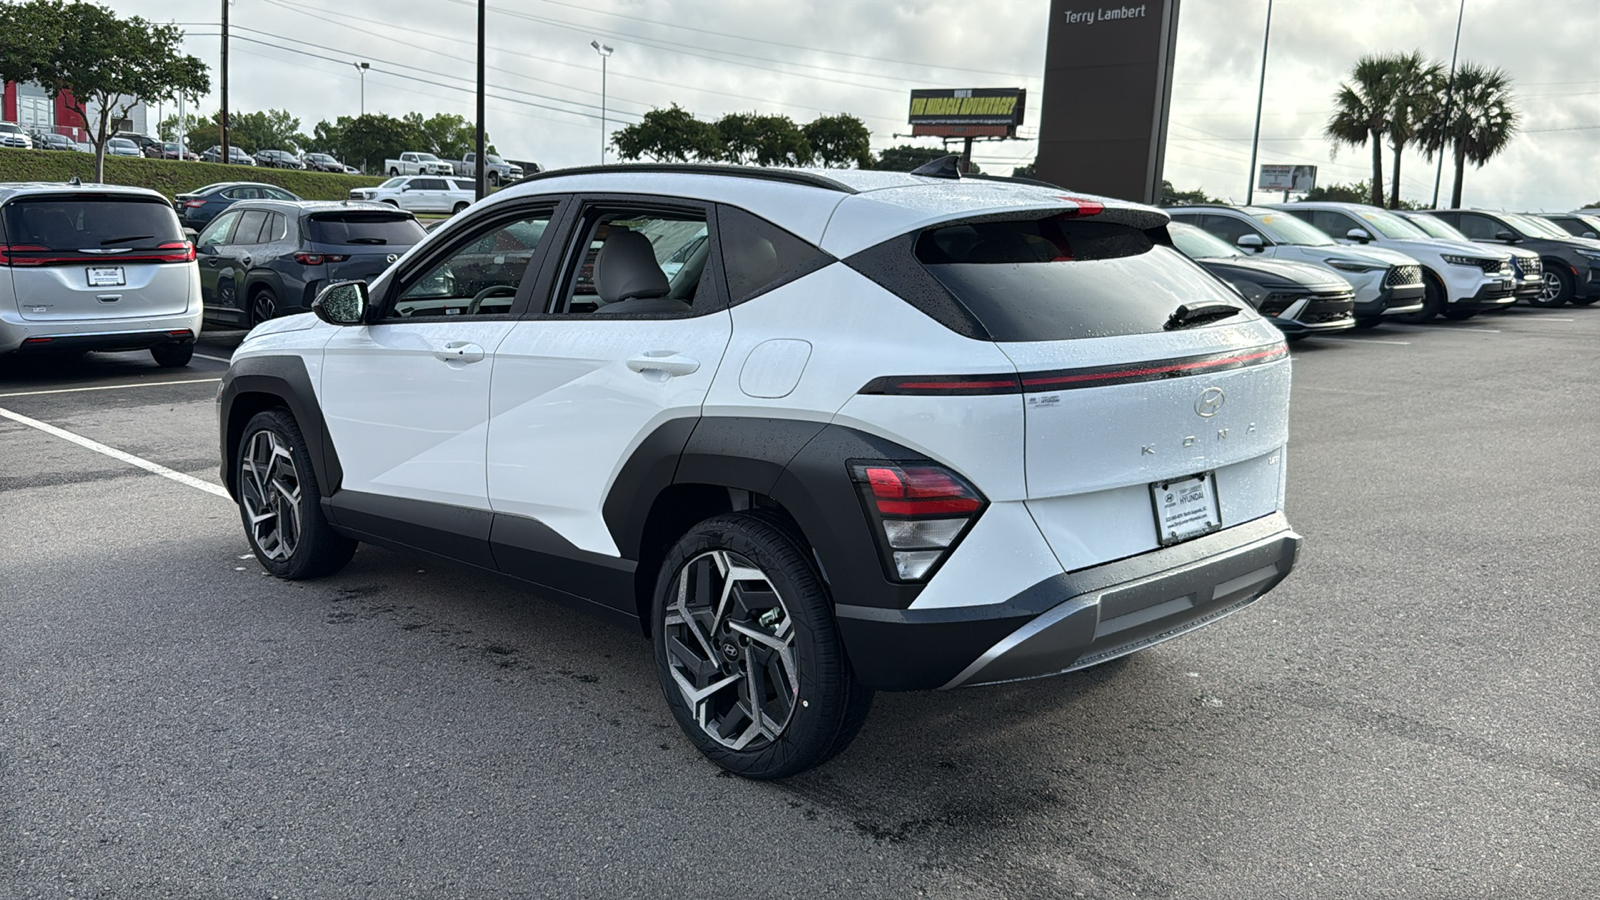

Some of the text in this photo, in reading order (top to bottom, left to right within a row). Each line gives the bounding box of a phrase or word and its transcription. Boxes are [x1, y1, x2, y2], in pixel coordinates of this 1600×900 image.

[1064, 4, 1146, 25] Terry Lambert
[910, 97, 1017, 115] THE MIRACLE ADVANTAGE?
[1141, 422, 1255, 456] KONA
[1179, 491, 1204, 505] HYUNDAI
